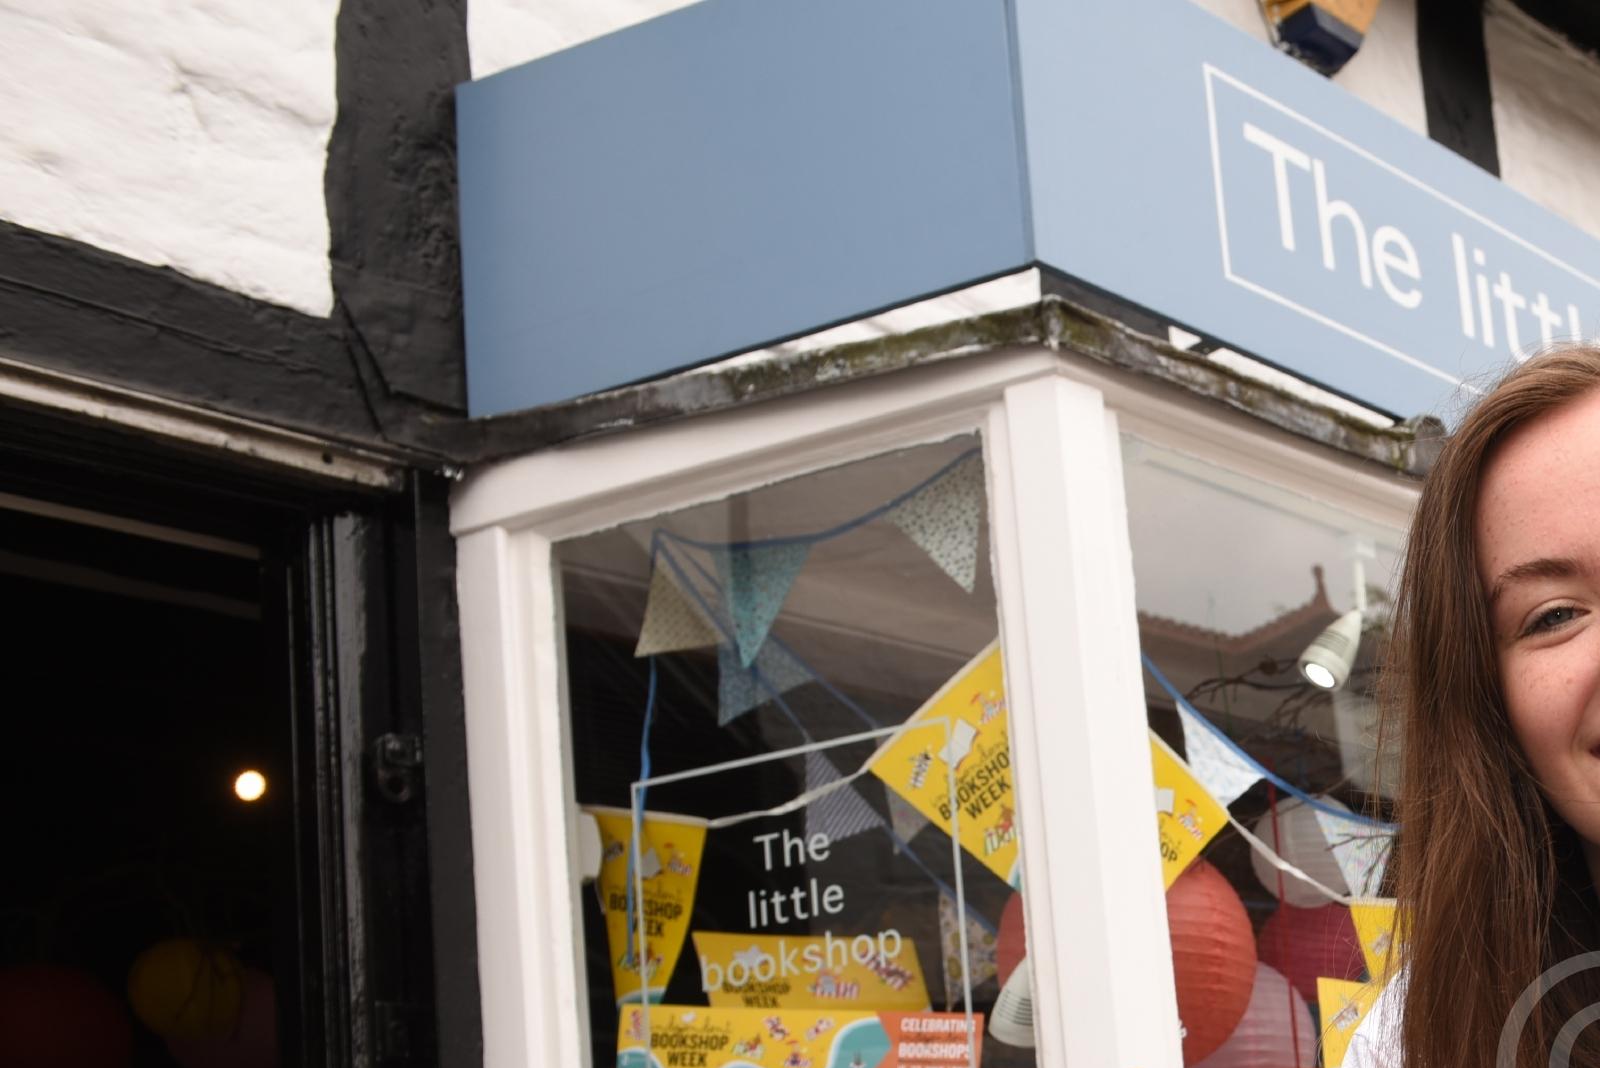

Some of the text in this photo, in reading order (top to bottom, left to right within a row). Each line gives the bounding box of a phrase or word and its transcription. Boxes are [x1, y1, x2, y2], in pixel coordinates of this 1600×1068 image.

[1243, 122, 1422, 310] The
[1451, 231, 1584, 365] litt
[939, 746, 1011, 821] BOKSHO
[965, 775, 1012, 820] WEEK
[753, 829, 831, 871] The
[748, 878, 844, 929] little
[701, 928, 901, 993] bookshop
[651, 1033, 729, 1051] BOOKSHOP
[667, 1052, 709, 1067] WEEK
